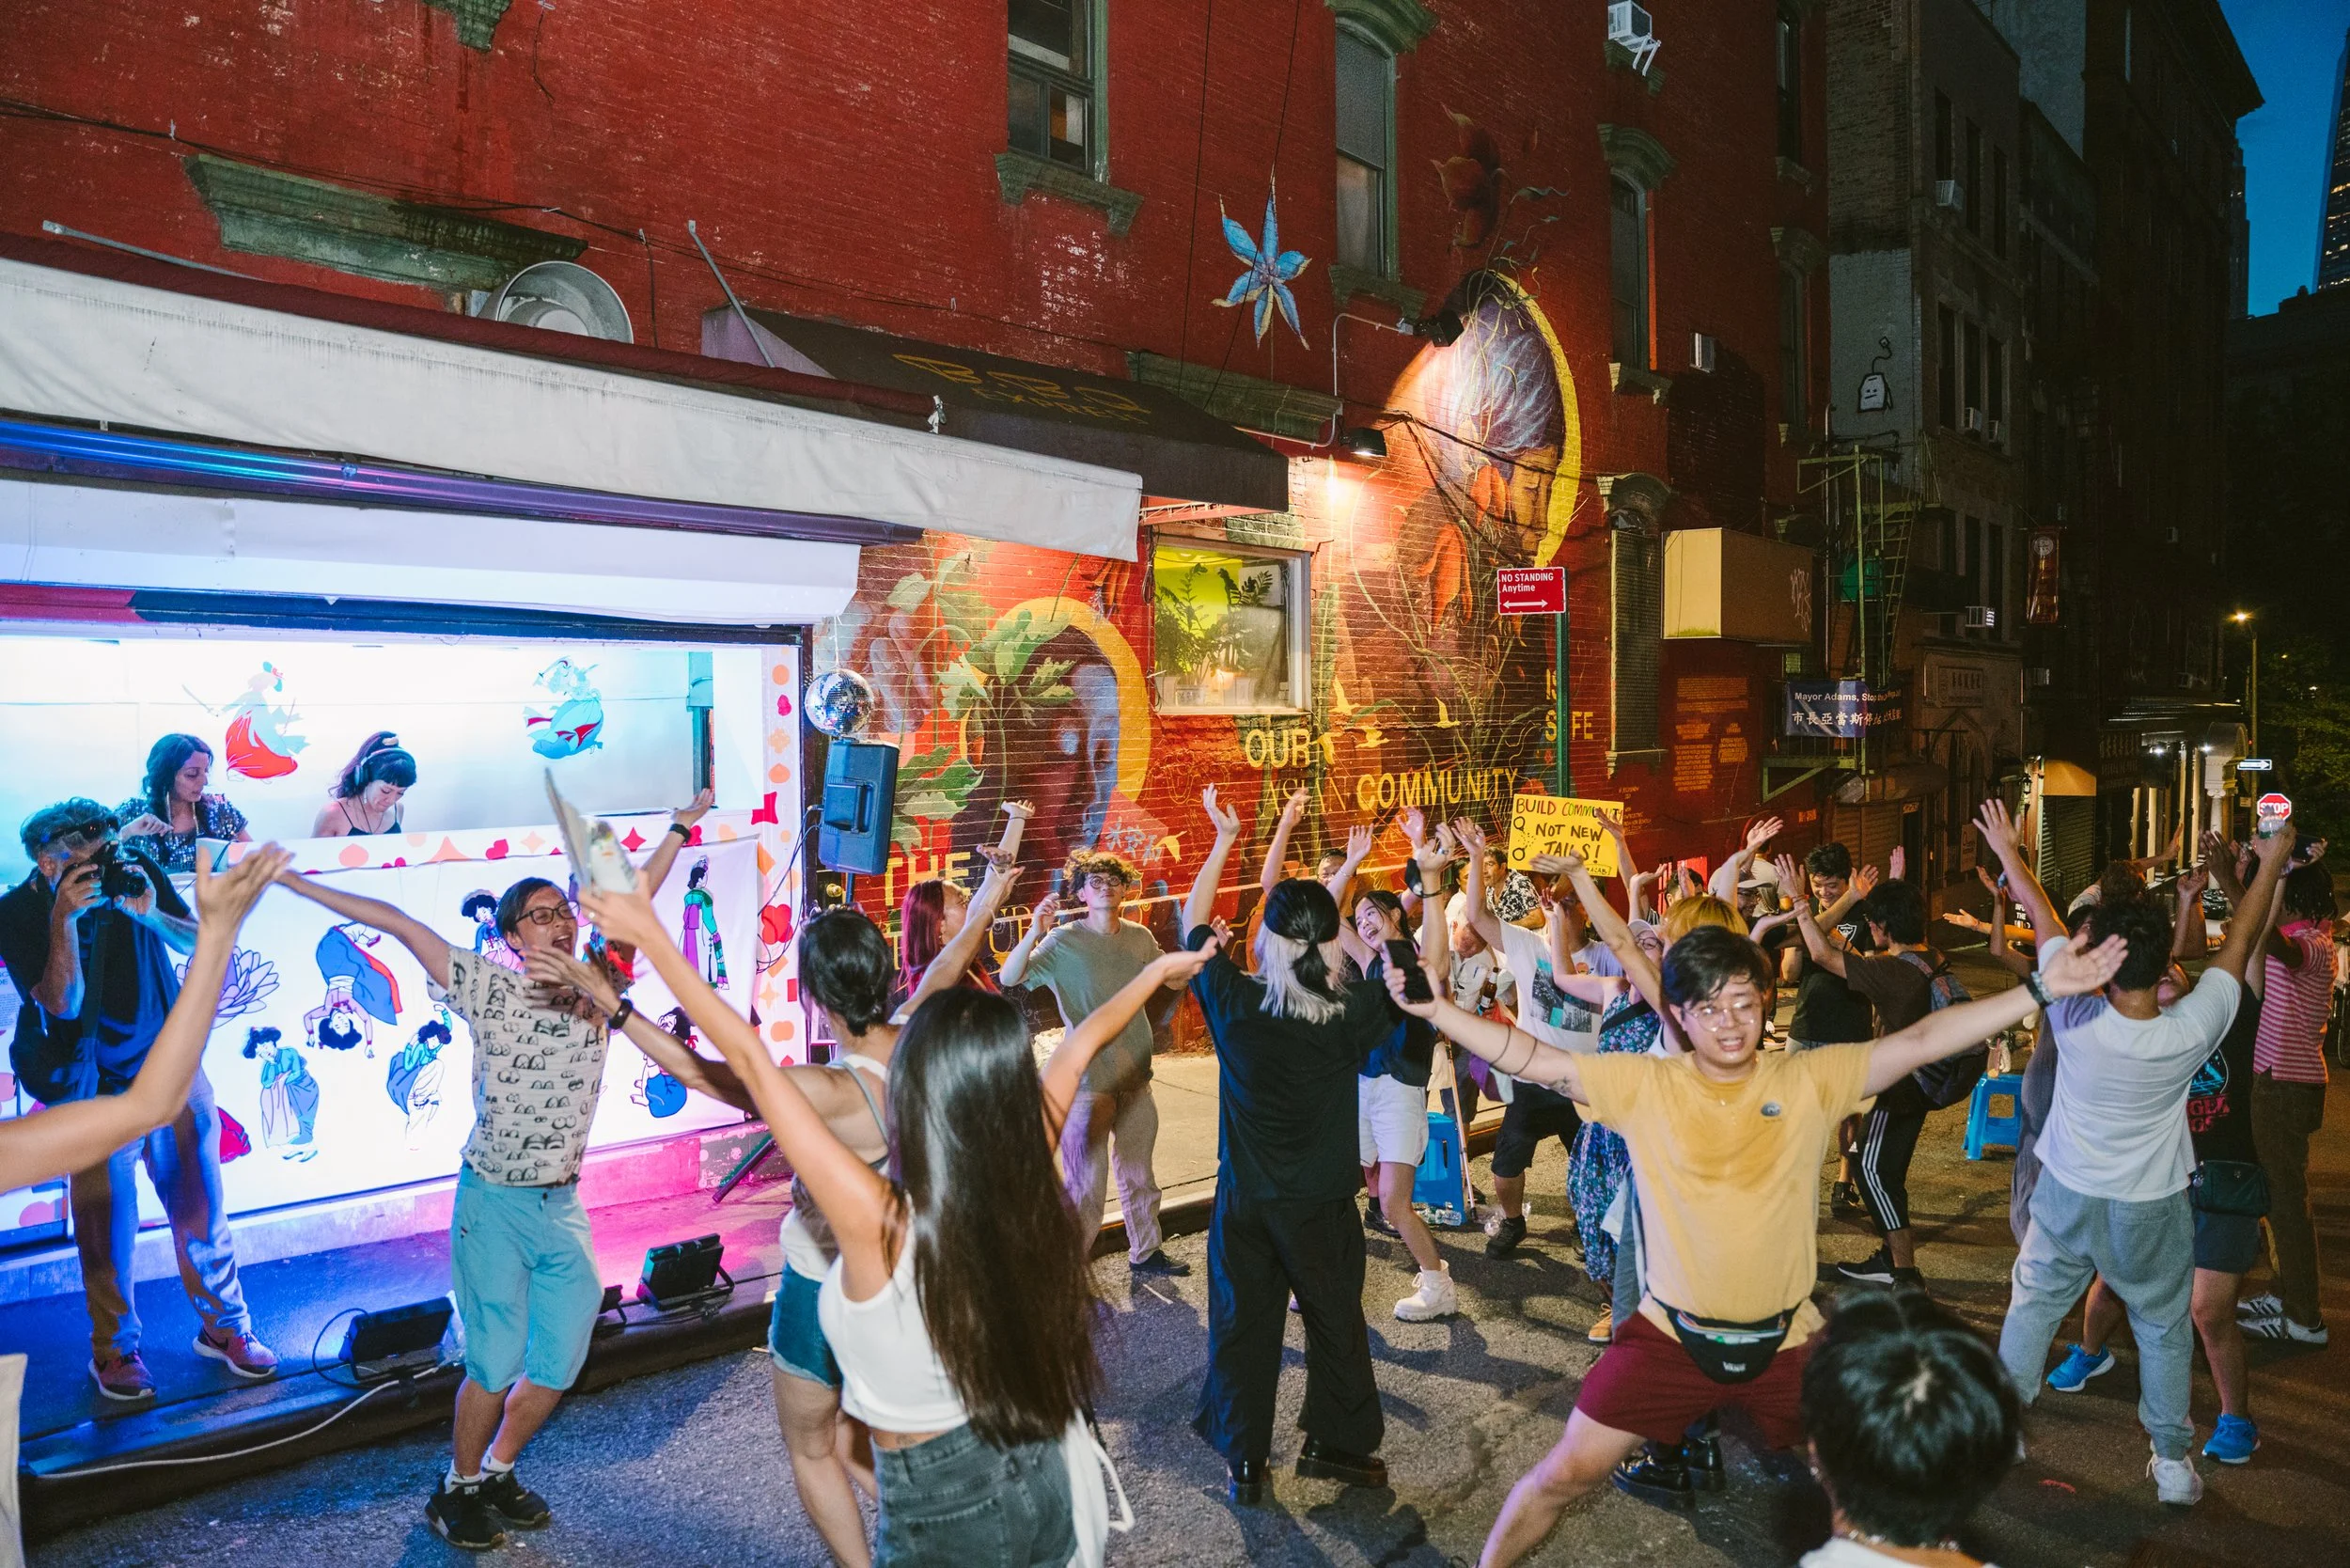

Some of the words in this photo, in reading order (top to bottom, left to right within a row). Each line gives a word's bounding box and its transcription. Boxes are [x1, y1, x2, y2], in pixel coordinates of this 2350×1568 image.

[1501, 573, 1513, 583] NO
[1514, 572, 1554, 582] STANDING
[1502, 583, 1536, 593] Anytime
[1794, 692, 1823, 703] Mayor
[1825, 693, 1859, 702] Adams,
[1544, 709, 1594, 742] SFE
[1245, 729, 1311, 769] OUR
[1355, 766, 1519, 811] COMMUNITY
[1516, 798, 1557, 815] BUILD
[2260, 802, 2290, 814] STOP
[1535, 823, 1566, 838] NOT
[1570, 825, 1605, 842] NEW
[885, 851, 971, 907] THE
